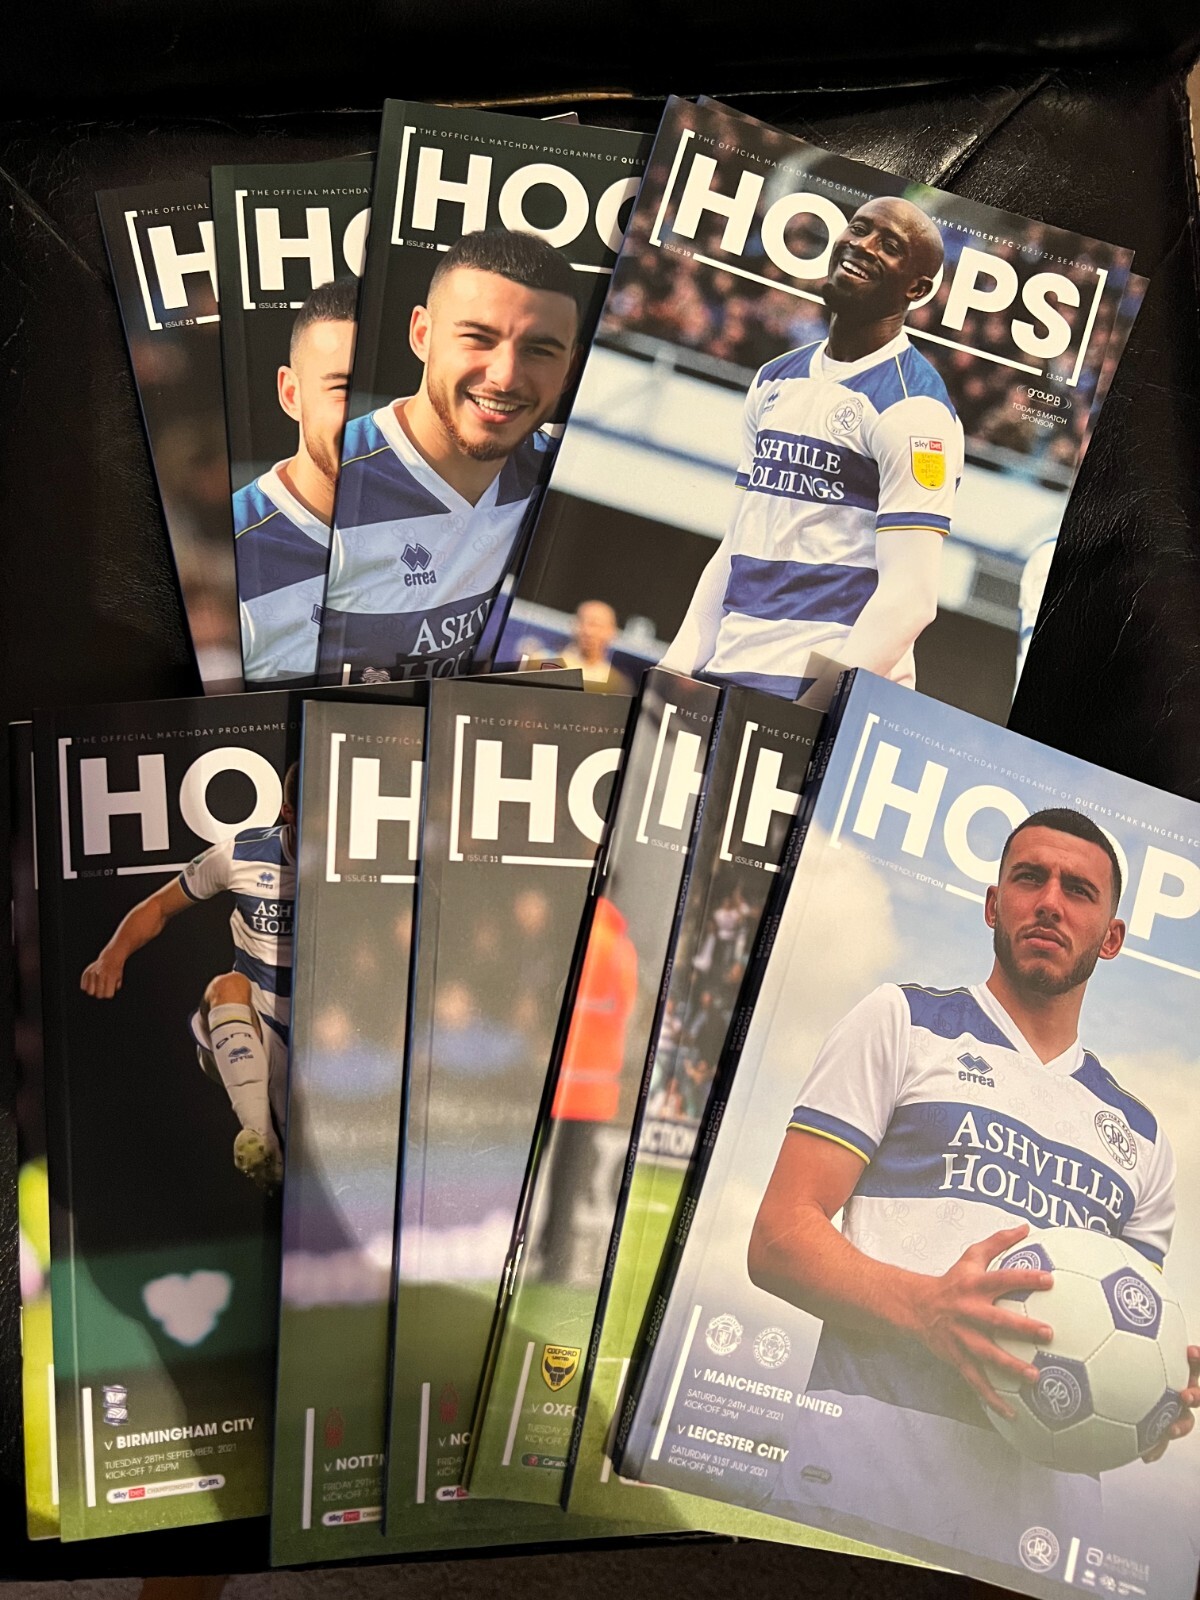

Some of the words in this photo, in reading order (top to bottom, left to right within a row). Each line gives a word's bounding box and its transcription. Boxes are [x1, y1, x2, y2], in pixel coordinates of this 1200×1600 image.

[419, 128, 438, 136] THE
[440, 131, 486, 144] OFFICIAL
[489, 138, 540, 152] MATCHDAY
[543, 146, 602, 160] PROGRAMME
[605, 154, 618, 162] OF
[698, 134, 716, 145] THE
[718, 142, 761, 162] OFFICIAL
[764, 158, 813, 180] MATCHDAY
[274, 188, 318, 196] OFFICIAL
[322, 187, 371, 196] MATCHDA
[140, 208, 158, 216] THE
[163, 203, 210, 214] OFFICIAL
[406, 240, 426, 248] ISSUE
[426, 242, 434, 250] 22
[664, 242, 682, 255] ISSUE
[682, 249, 691, 258] 19
[931, 216, 954, 228] PARK
[956, 224, 1000, 243] RANGERS
[1002, 239, 1014, 248] FC
[1016, 244, 1054, 260] 2021/22
[1057, 256, 1094, 272] SEASON
[164, 320, 185, 328] ISSUE
[185, 318, 194, 326] 25
[1021, 414, 1054, 429] SPONSOR
[1042, 412, 1068, 425] MATCH
[914, 440, 928, 450] sky
[404, 570, 437, 586] errea
[680, 708, 697, 720] THE
[474, 716, 494, 725] THE
[500, 719, 548, 730] OFFICIAL
[554, 723, 609, 734] MATCHDAY
[762, 726, 779, 736] THE
[76, 736, 96, 744] THE
[102, 733, 152, 743] OFFICIAL
[158, 728, 214, 738] MATCHDAY
[218, 722, 286, 734] PROGRAMME
[350, 734, 372, 743] THE
[883, 720, 900, 732] THE
[902, 728, 944, 750] OFFICIAL
[949, 748, 998, 771] MATCHDAY
[1000, 768, 1056, 796] PROGRAMME
[1060, 792, 1070, 800] OF
[1075, 797, 1112, 816] QUEENS
[1115, 812, 1138, 826] PARK
[1141, 822, 1184, 842] RANGERS
[1188, 838, 1200, 848] FC
[694, 792, 706, 833] HOOPS
[652, 839, 670, 850] ISSUE
[670, 844, 680, 852] 03
[467, 854, 488, 862] ISSUE
[735, 856, 754, 866] ISSUE
[754, 860, 762, 868] 01
[104, 868, 114, 876] 07
[916, 873, 944, 888] EDITION
[678, 874, 690, 916] HOOPS
[958, 1070, 995, 1088] errea
[948, 1112, 1124, 1220] ASHVILLE
[546, 1347, 578, 1356] OXFORD
[704, 1368, 792, 1404] MANCHESTER
[796, 1395, 842, 1418] UNITED
[684, 1399, 722, 1416] KICK-OFF
[723, 1408, 740, 1420] 3PM
[686, 1388, 726, 1406] SATURDAY
[728, 1397, 746, 1410] 24TH
[748, 1402, 766, 1416] JULY
[766, 1408, 784, 1422] 2021
[116, 1422, 218, 1448] BIRMINGHAM
[222, 1418, 254, 1434] CITY
[688, 1424, 754, 1454] LEICESTER
[757, 1442, 788, 1462] CITY
[104, 1456, 142, 1470] TUESDAY
[144, 1453, 164, 1464] 28TH
[166, 1446, 214, 1460] SEPTEMBER
[668, 1454, 705, 1472] KICK-OFF
[706, 1465, 724, 1477] 3PM
[671, 1444, 712, 1462] SATURDAY
[712, 1452, 730, 1468] 31ST
[730, 1458, 749, 1473] JULY
[750, 1464, 769, 1478] 2021
[105, 1466, 145, 1480] KICK-OFF
[113, 1492, 128, 1500] sky
[442, 1489, 456, 1497] sky
[328, 1514, 342, 1522] sky
